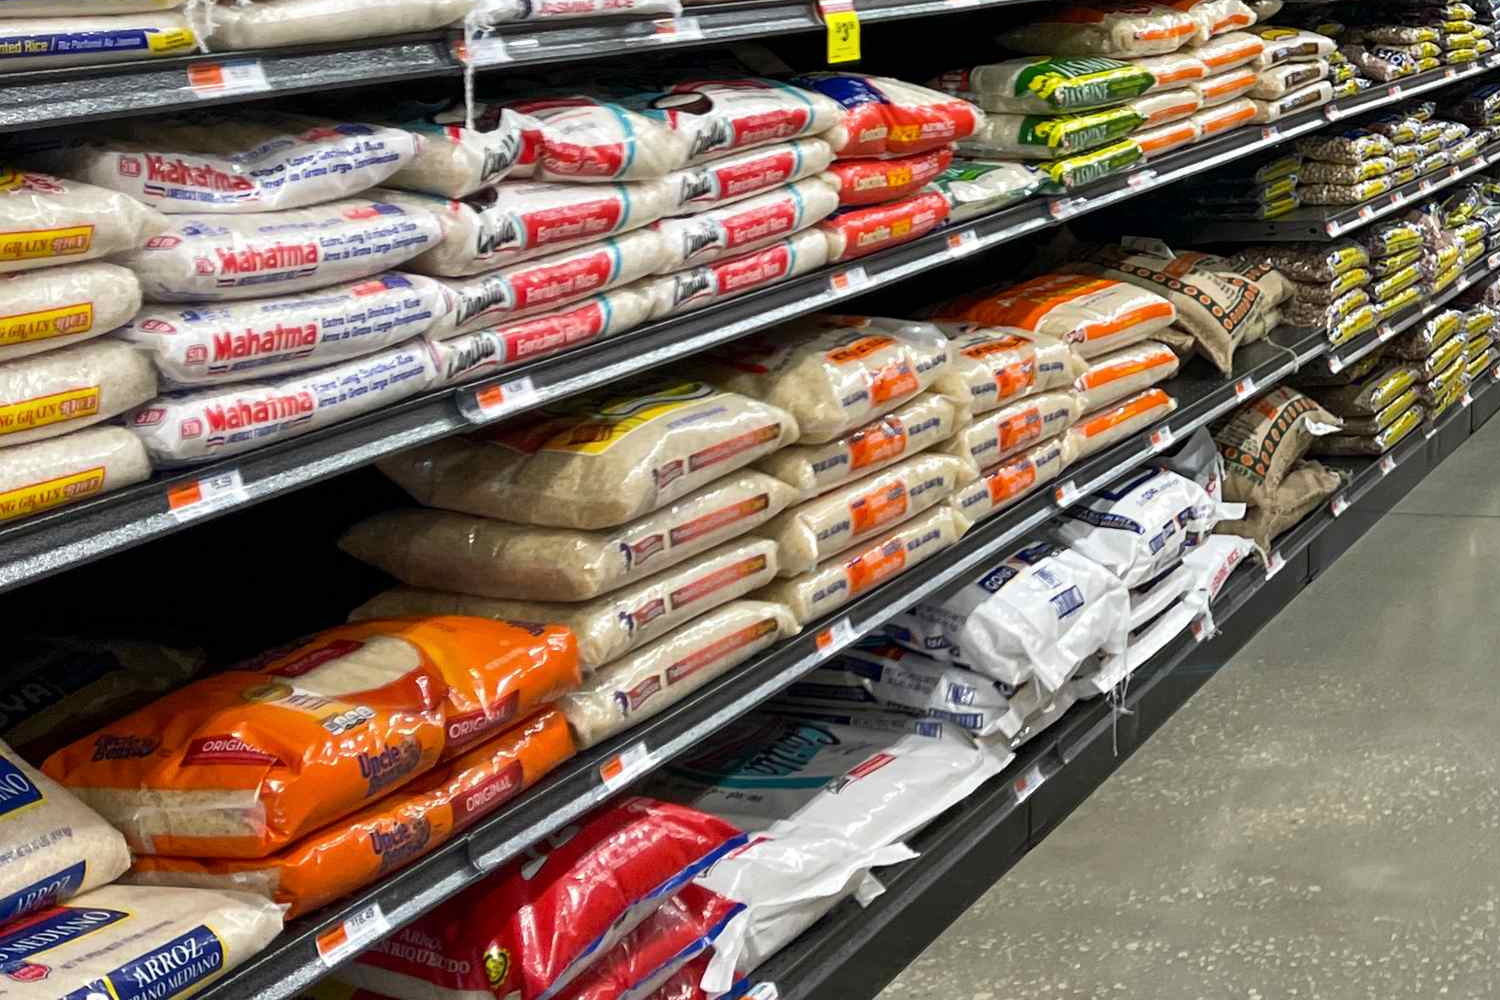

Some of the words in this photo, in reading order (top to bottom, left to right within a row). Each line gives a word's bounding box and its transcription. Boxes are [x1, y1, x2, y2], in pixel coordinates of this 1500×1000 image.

[24, 39, 48, 51] Rice
[58, 39, 70, 50] Riz
[144, 152, 256, 192] Mahatma
[4, 238, 50, 256] GRAIN
[214, 240, 320, 275] Mahatma
[8, 318, 50, 336] GRAIN
[212, 321, 319, 363] Mahatma
[17, 405, 57, 426] GRAIN
[203, 390, 316, 433] Mahatma
[18, 488, 61, 510] GRAIN
[202, 739, 266, 756] ORIGIN
[357, 745, 402, 780] Uncle
[465, 775, 513, 812] ORIGINAL
[16, 875, 72, 914] ARROZ
[11, 909, 112, 955] MEDIANO
[400, 928, 443, 952] ARRO
[126, 977, 168, 1000] RANO
[168, 950, 221, 992] MEDIANO
[133, 936, 206, 989] ARROZ
